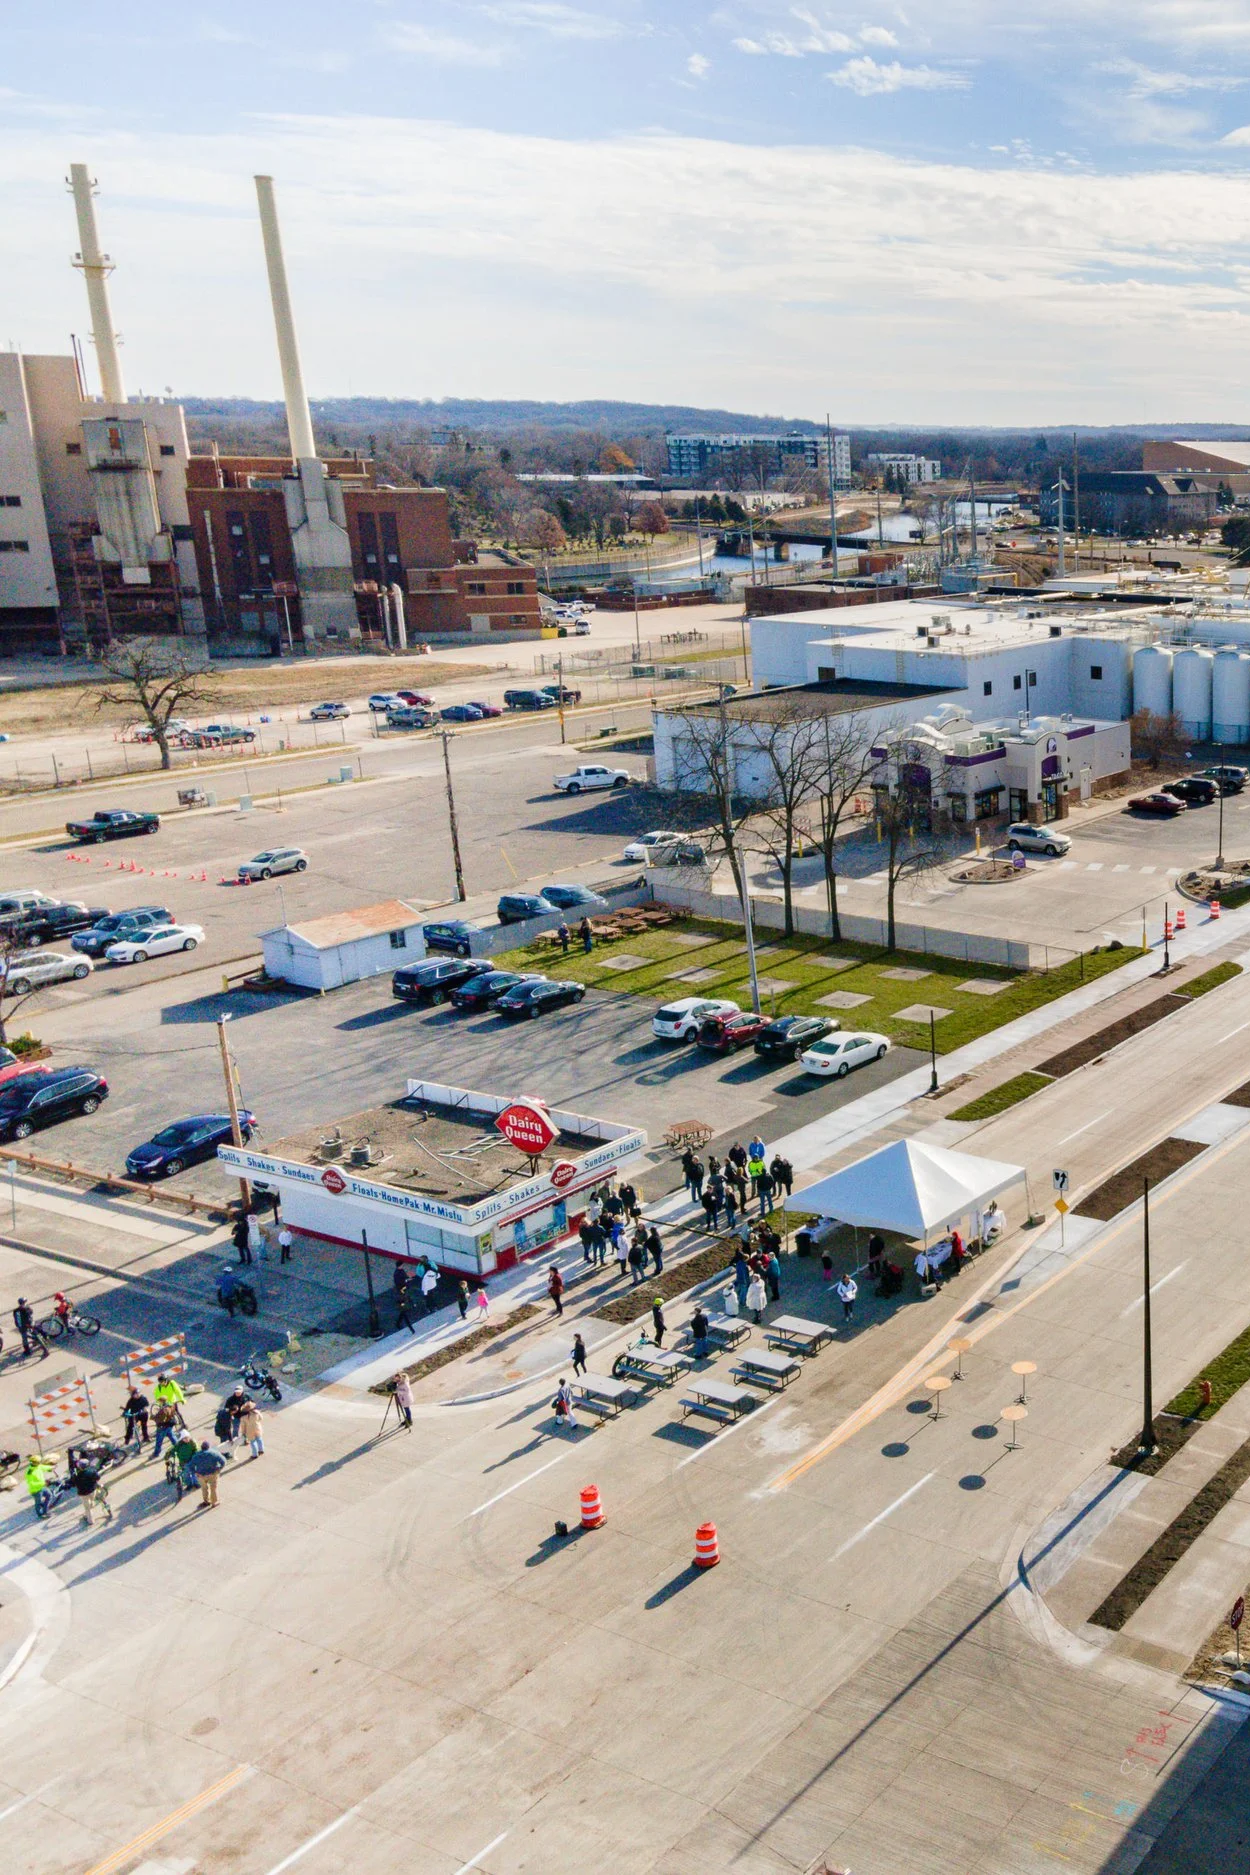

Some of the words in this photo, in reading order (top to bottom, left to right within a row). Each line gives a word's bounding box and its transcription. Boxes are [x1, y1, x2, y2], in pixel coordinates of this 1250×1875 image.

[508, 1114, 542, 1134] Dairy
[218, 1150, 240, 1164] Splits
[247, 1157, 275, 1172] Shakes
[282, 1165, 315, 1181] Sundaes
[584, 1150, 615, 1169] Sundaes
[619, 1138, 641, 1154] Floats
[352, 1183, 379, 1198] Floats
[475, 1203, 502, 1220] Splits
[509, 1185, 541, 1204] Shakes
